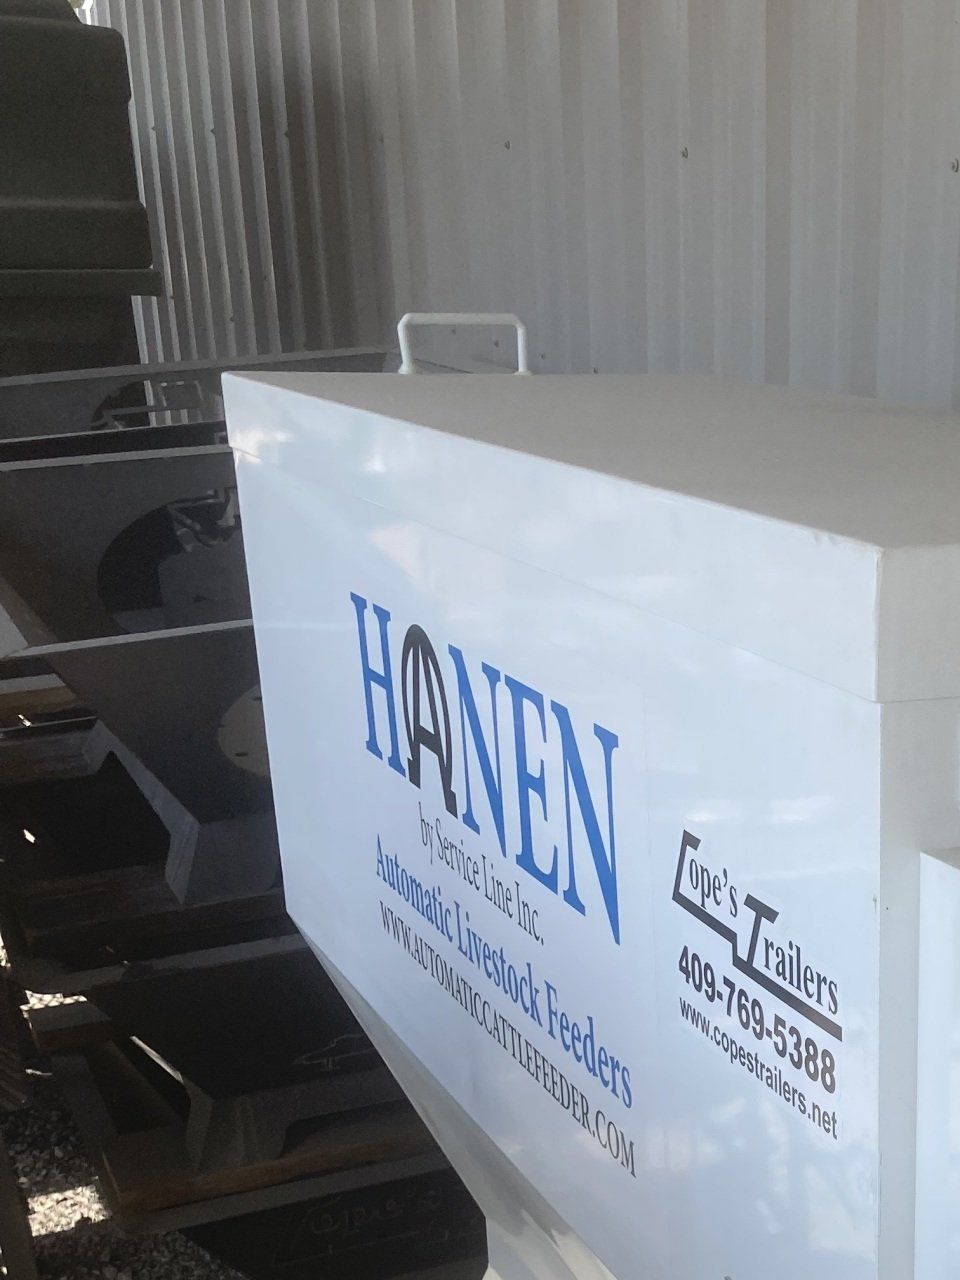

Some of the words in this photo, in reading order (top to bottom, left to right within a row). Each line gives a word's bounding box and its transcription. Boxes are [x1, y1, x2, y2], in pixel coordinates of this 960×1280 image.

[350, 591, 620, 946] HANEN
[375, 833, 454, 944] Automatic
[454, 900, 543, 1029] Livestock
[545, 979, 633, 1109] Feeders
[418, 801, 435, 866] by
[435, 816, 481, 891] Service
[481, 855, 513, 919] Line
[515, 880, 546, 946] Inc.
[672, 829, 739, 935] Cope's
[735, 893, 842, 1030] Trailers
[379, 900, 637, 1178] WWW.AUTOMATICCATTLEFEEDER.COM
[678, 944, 837, 1095] 409-769-5388
[679, 996, 838, 1140] www.copestrailers.net
